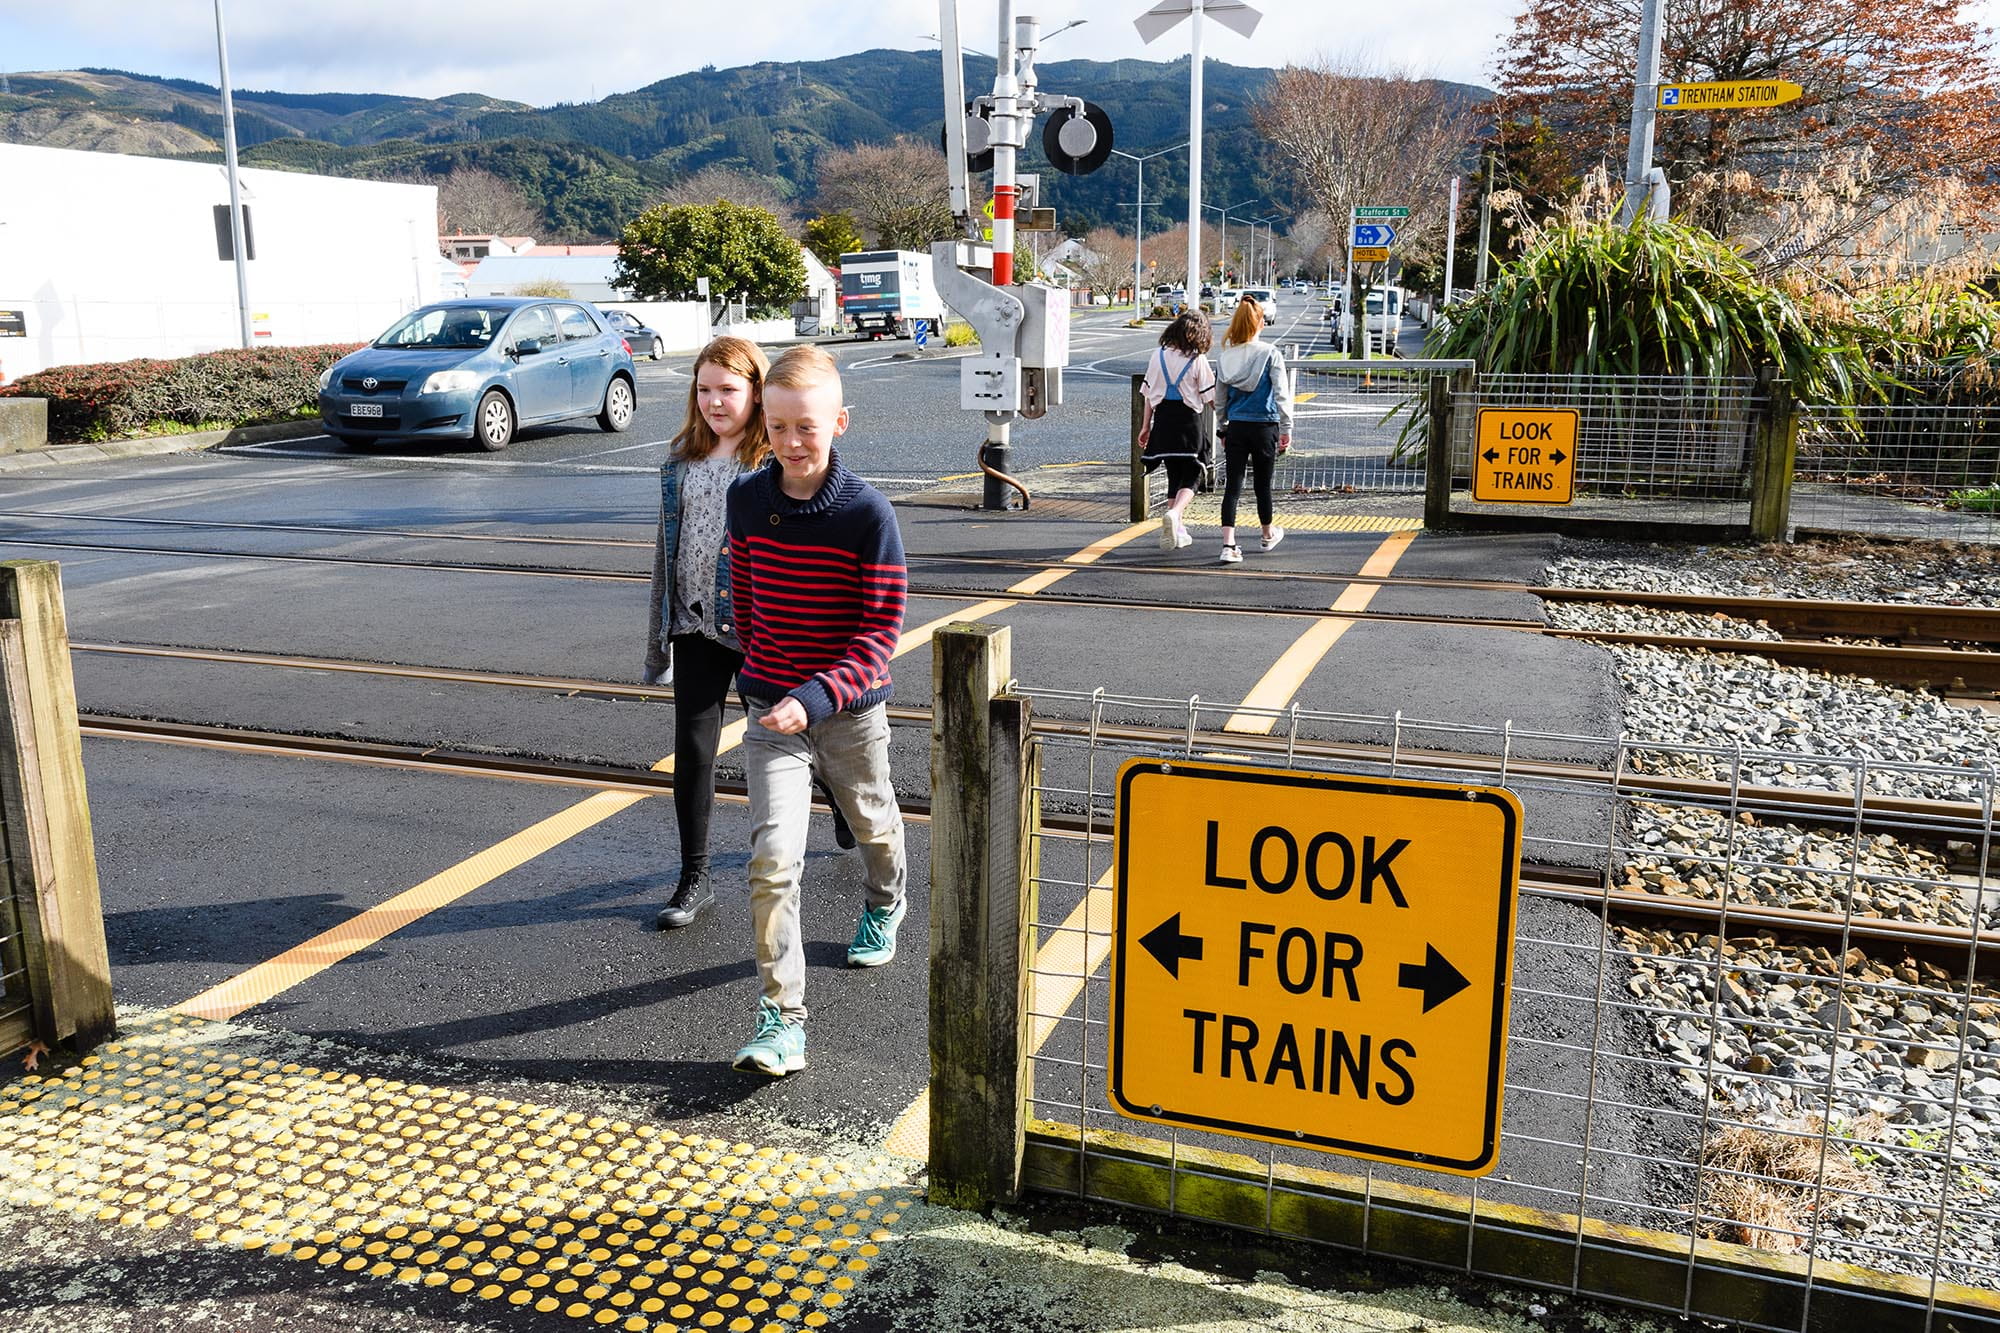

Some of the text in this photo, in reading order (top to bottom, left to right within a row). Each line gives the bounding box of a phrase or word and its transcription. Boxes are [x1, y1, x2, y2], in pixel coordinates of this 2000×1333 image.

[1682, 87, 1735, 104] TRENTHAM
[1738, 85, 1779, 102] STATION
[1360, 208, 1389, 216] Stafford
[860, 273, 882, 286] timg
[352, 405, 382, 416] EBE960
[1500, 422, 1553, 440] LOOK
[1508, 447, 1541, 465] FOR
[1493, 471, 1554, 490] TRAINS
[1204, 820, 1412, 908] LOOK
[1238, 921, 1364, 1002] FOR
[1183, 1009, 1417, 1106] TRAINS
